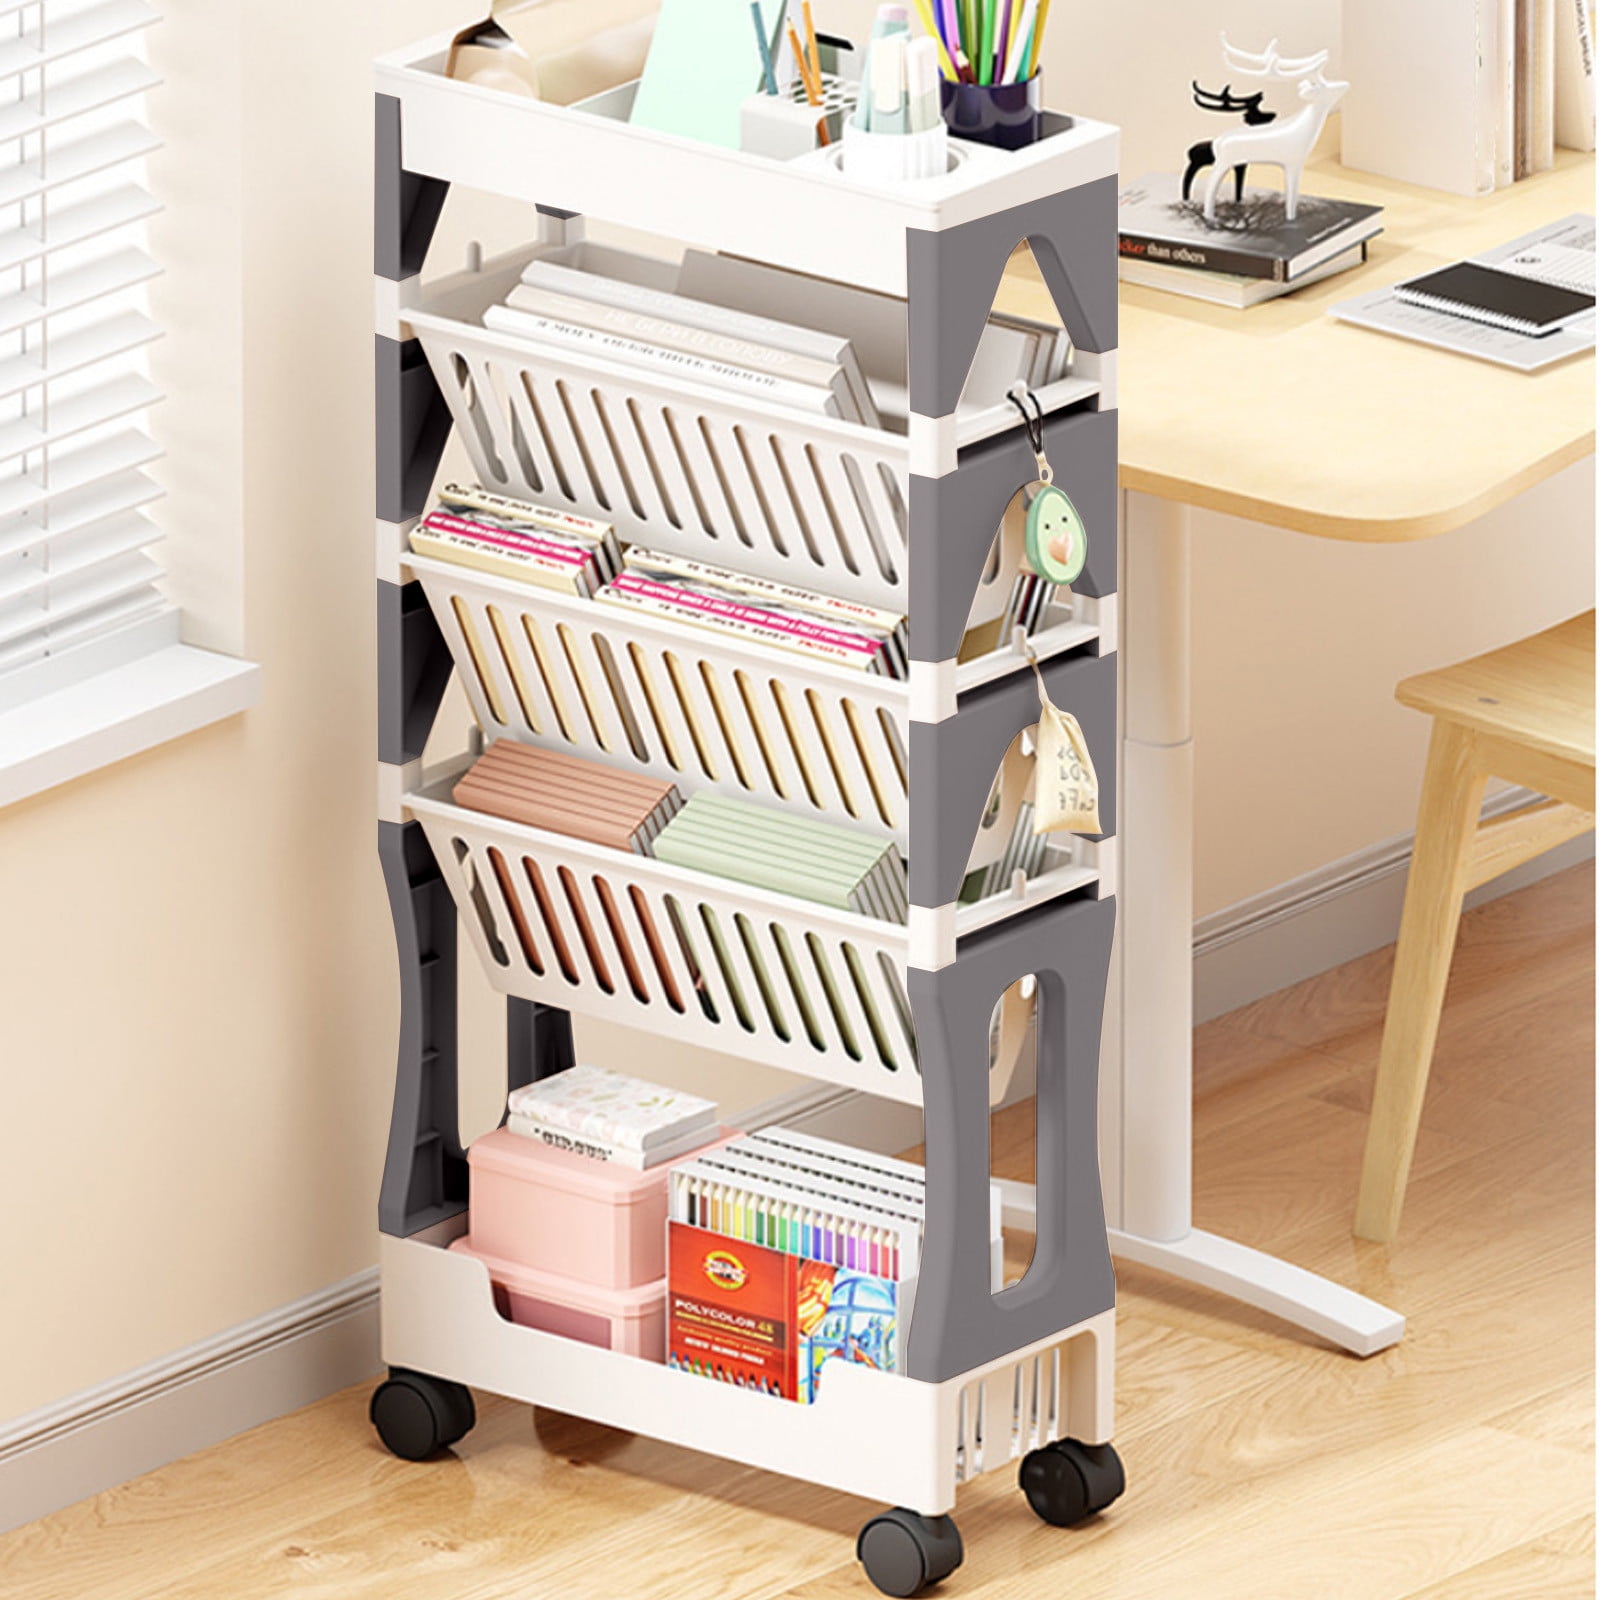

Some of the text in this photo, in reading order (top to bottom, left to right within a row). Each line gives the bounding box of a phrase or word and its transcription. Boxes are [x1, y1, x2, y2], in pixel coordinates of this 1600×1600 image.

[1147, 242, 1170, 258] than
[1172, 247, 1206, 264] others
[675, 1299, 756, 1329] POLYCOLOR
